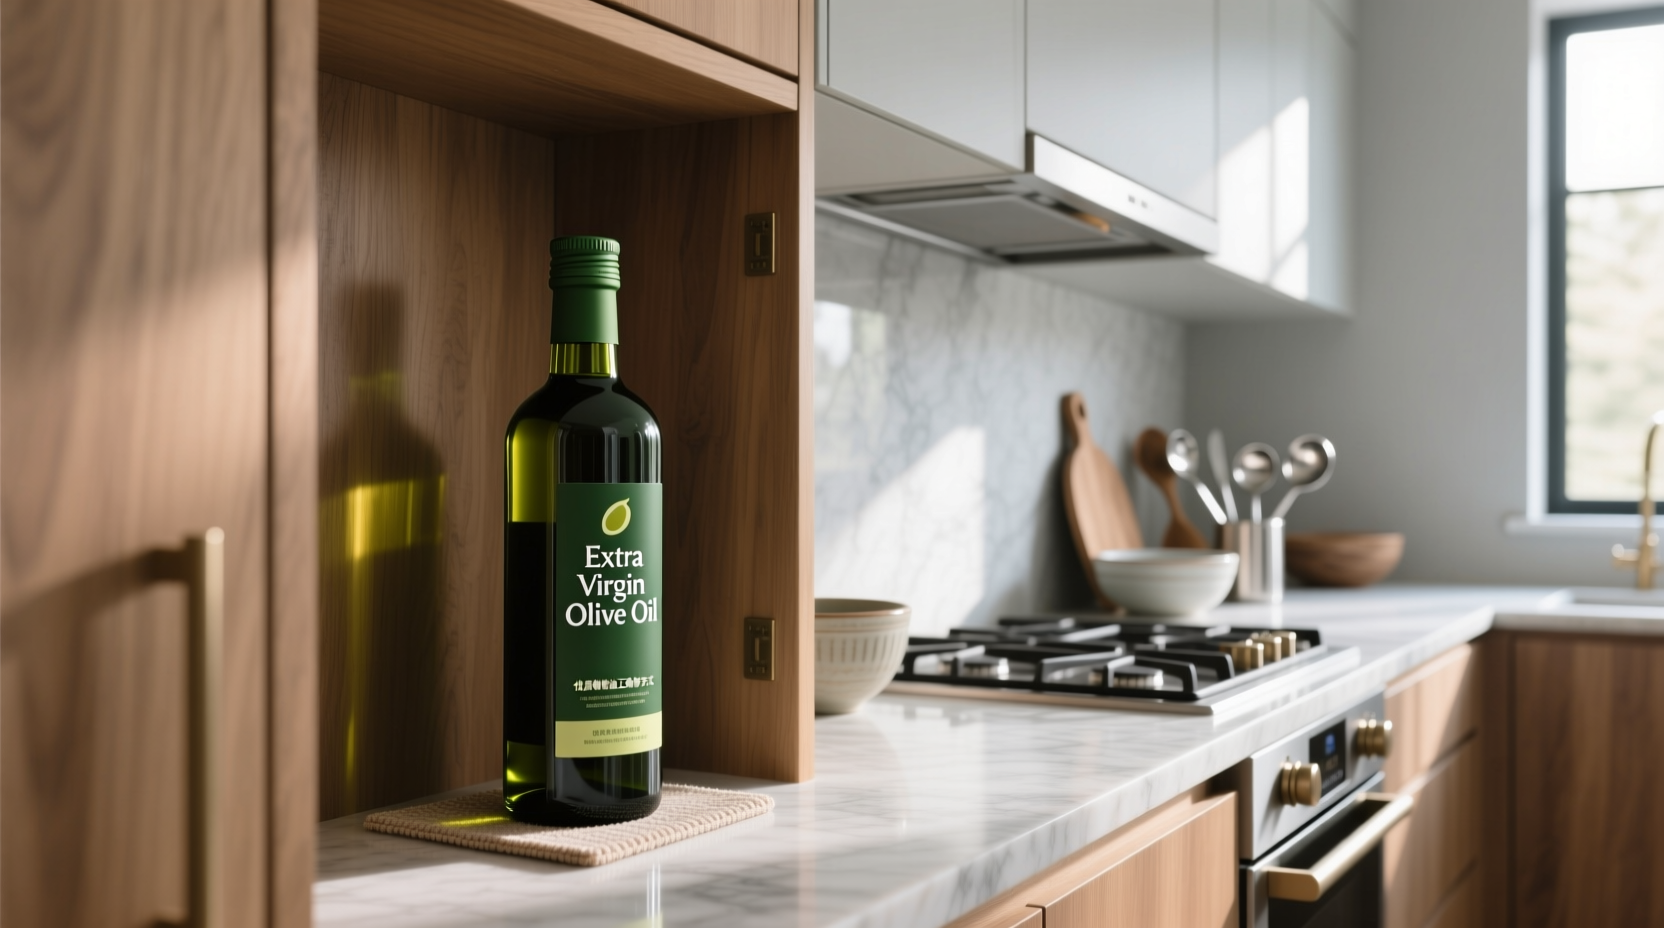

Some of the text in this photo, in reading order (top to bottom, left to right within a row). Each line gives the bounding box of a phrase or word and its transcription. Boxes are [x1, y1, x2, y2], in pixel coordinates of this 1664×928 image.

[584, 545, 644, 568] Extra
[576, 573, 645, 603] Virgin
[565, 597, 657, 627] Olive Oil
